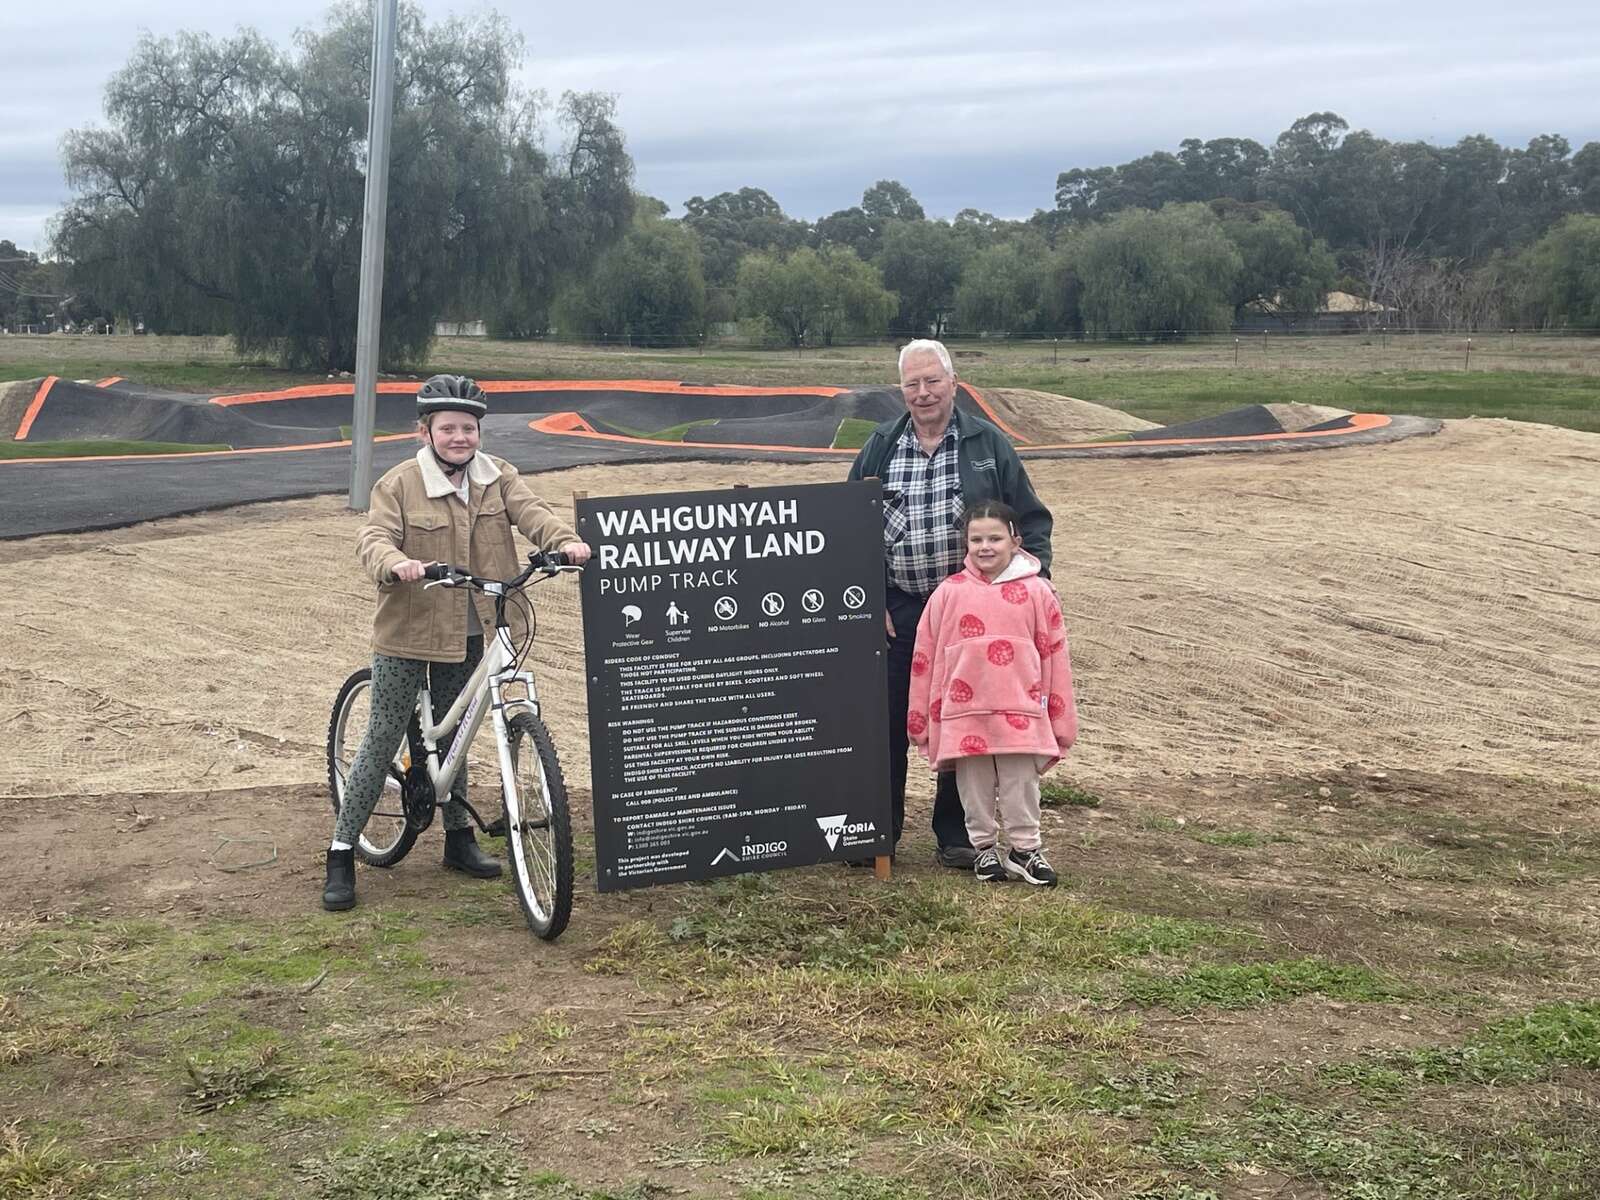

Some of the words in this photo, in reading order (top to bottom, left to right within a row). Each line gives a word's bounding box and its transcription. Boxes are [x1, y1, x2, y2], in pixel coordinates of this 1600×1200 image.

[596, 499, 797, 537] WAHGUNYAH
[599, 535, 736, 569] RAILWAY
[745, 529, 825, 558] LAND
[600, 574, 661, 594] PUMP
[669, 568, 738, 589] TRACK
[665, 628, 691, 637] Supervise
[747, 714, 782, 722] CONDITIONS
[653, 748, 690, 757] SUPERVISION
[698, 744, 726, 752] REQUIRED
[643, 786, 677, 795] EMERGENCY
[676, 805, 717, 815] MAINTENANCE
[626, 822, 654, 830] CONTACT
[821, 821, 875, 837] VICTORIA
[842, 837, 874, 846] Government
[741, 840, 787, 856] INDIGO
[661, 850, 689, 858] developed
[624, 861, 655, 870] partnership
